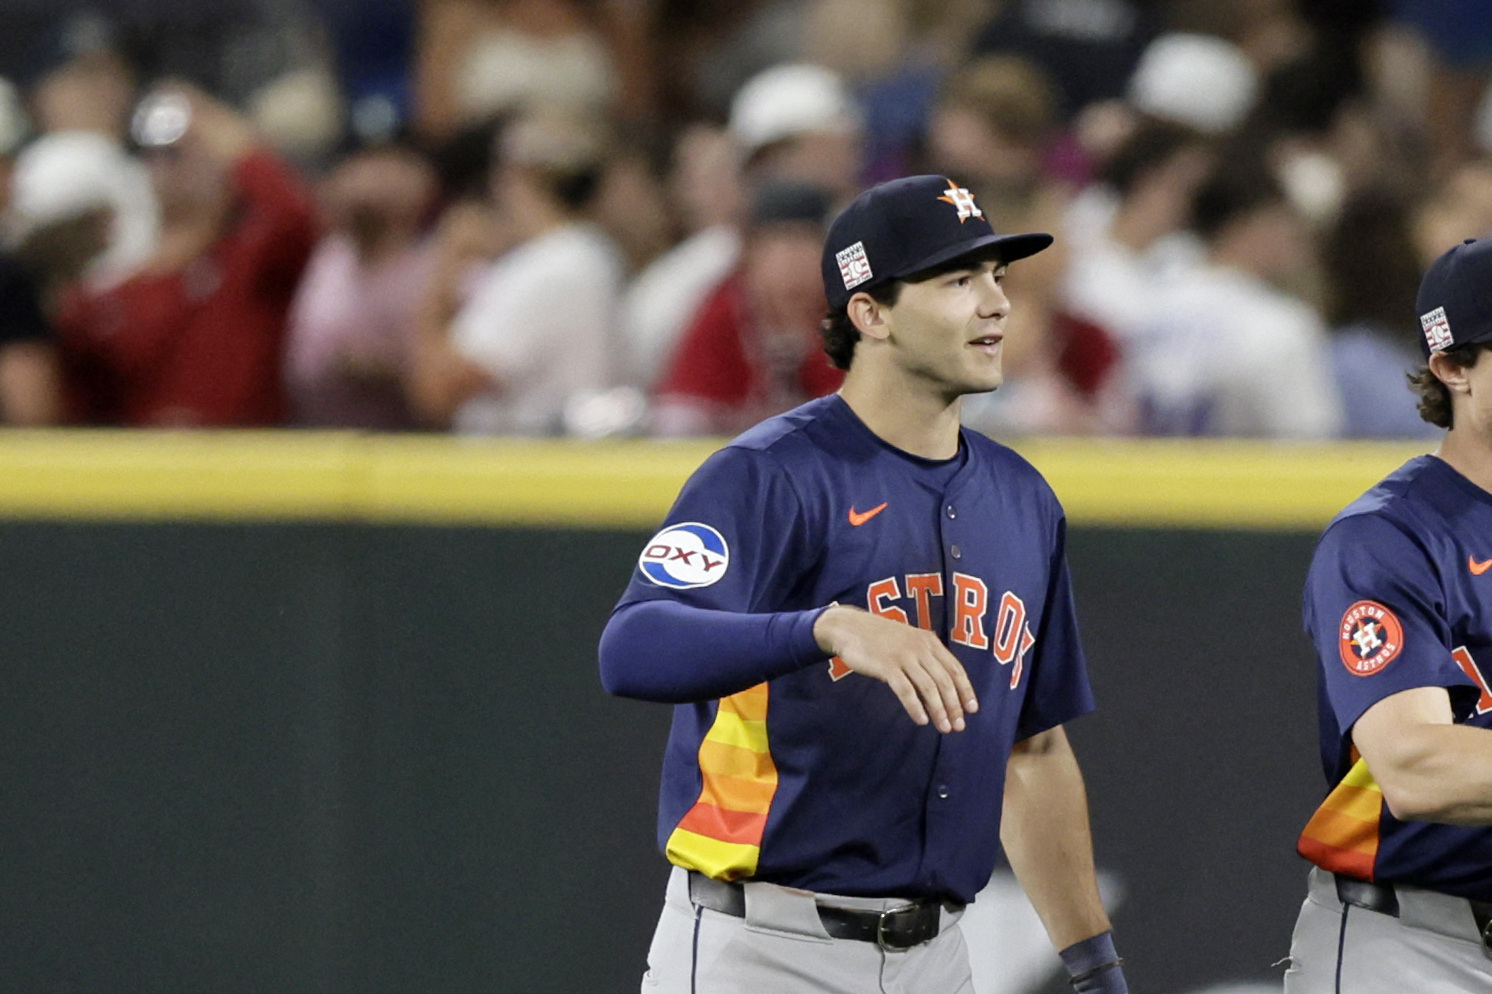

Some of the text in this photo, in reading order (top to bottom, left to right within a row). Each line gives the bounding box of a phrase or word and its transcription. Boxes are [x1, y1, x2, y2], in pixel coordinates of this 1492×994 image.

[943, 188, 982, 218] H
[644, 544, 724, 572] OXY
[828, 571, 1036, 692] STRO
[1342, 606, 1385, 640] HOUSTON
[1353, 621, 1383, 657] H
[1355, 642, 1397, 671] ASTROS
